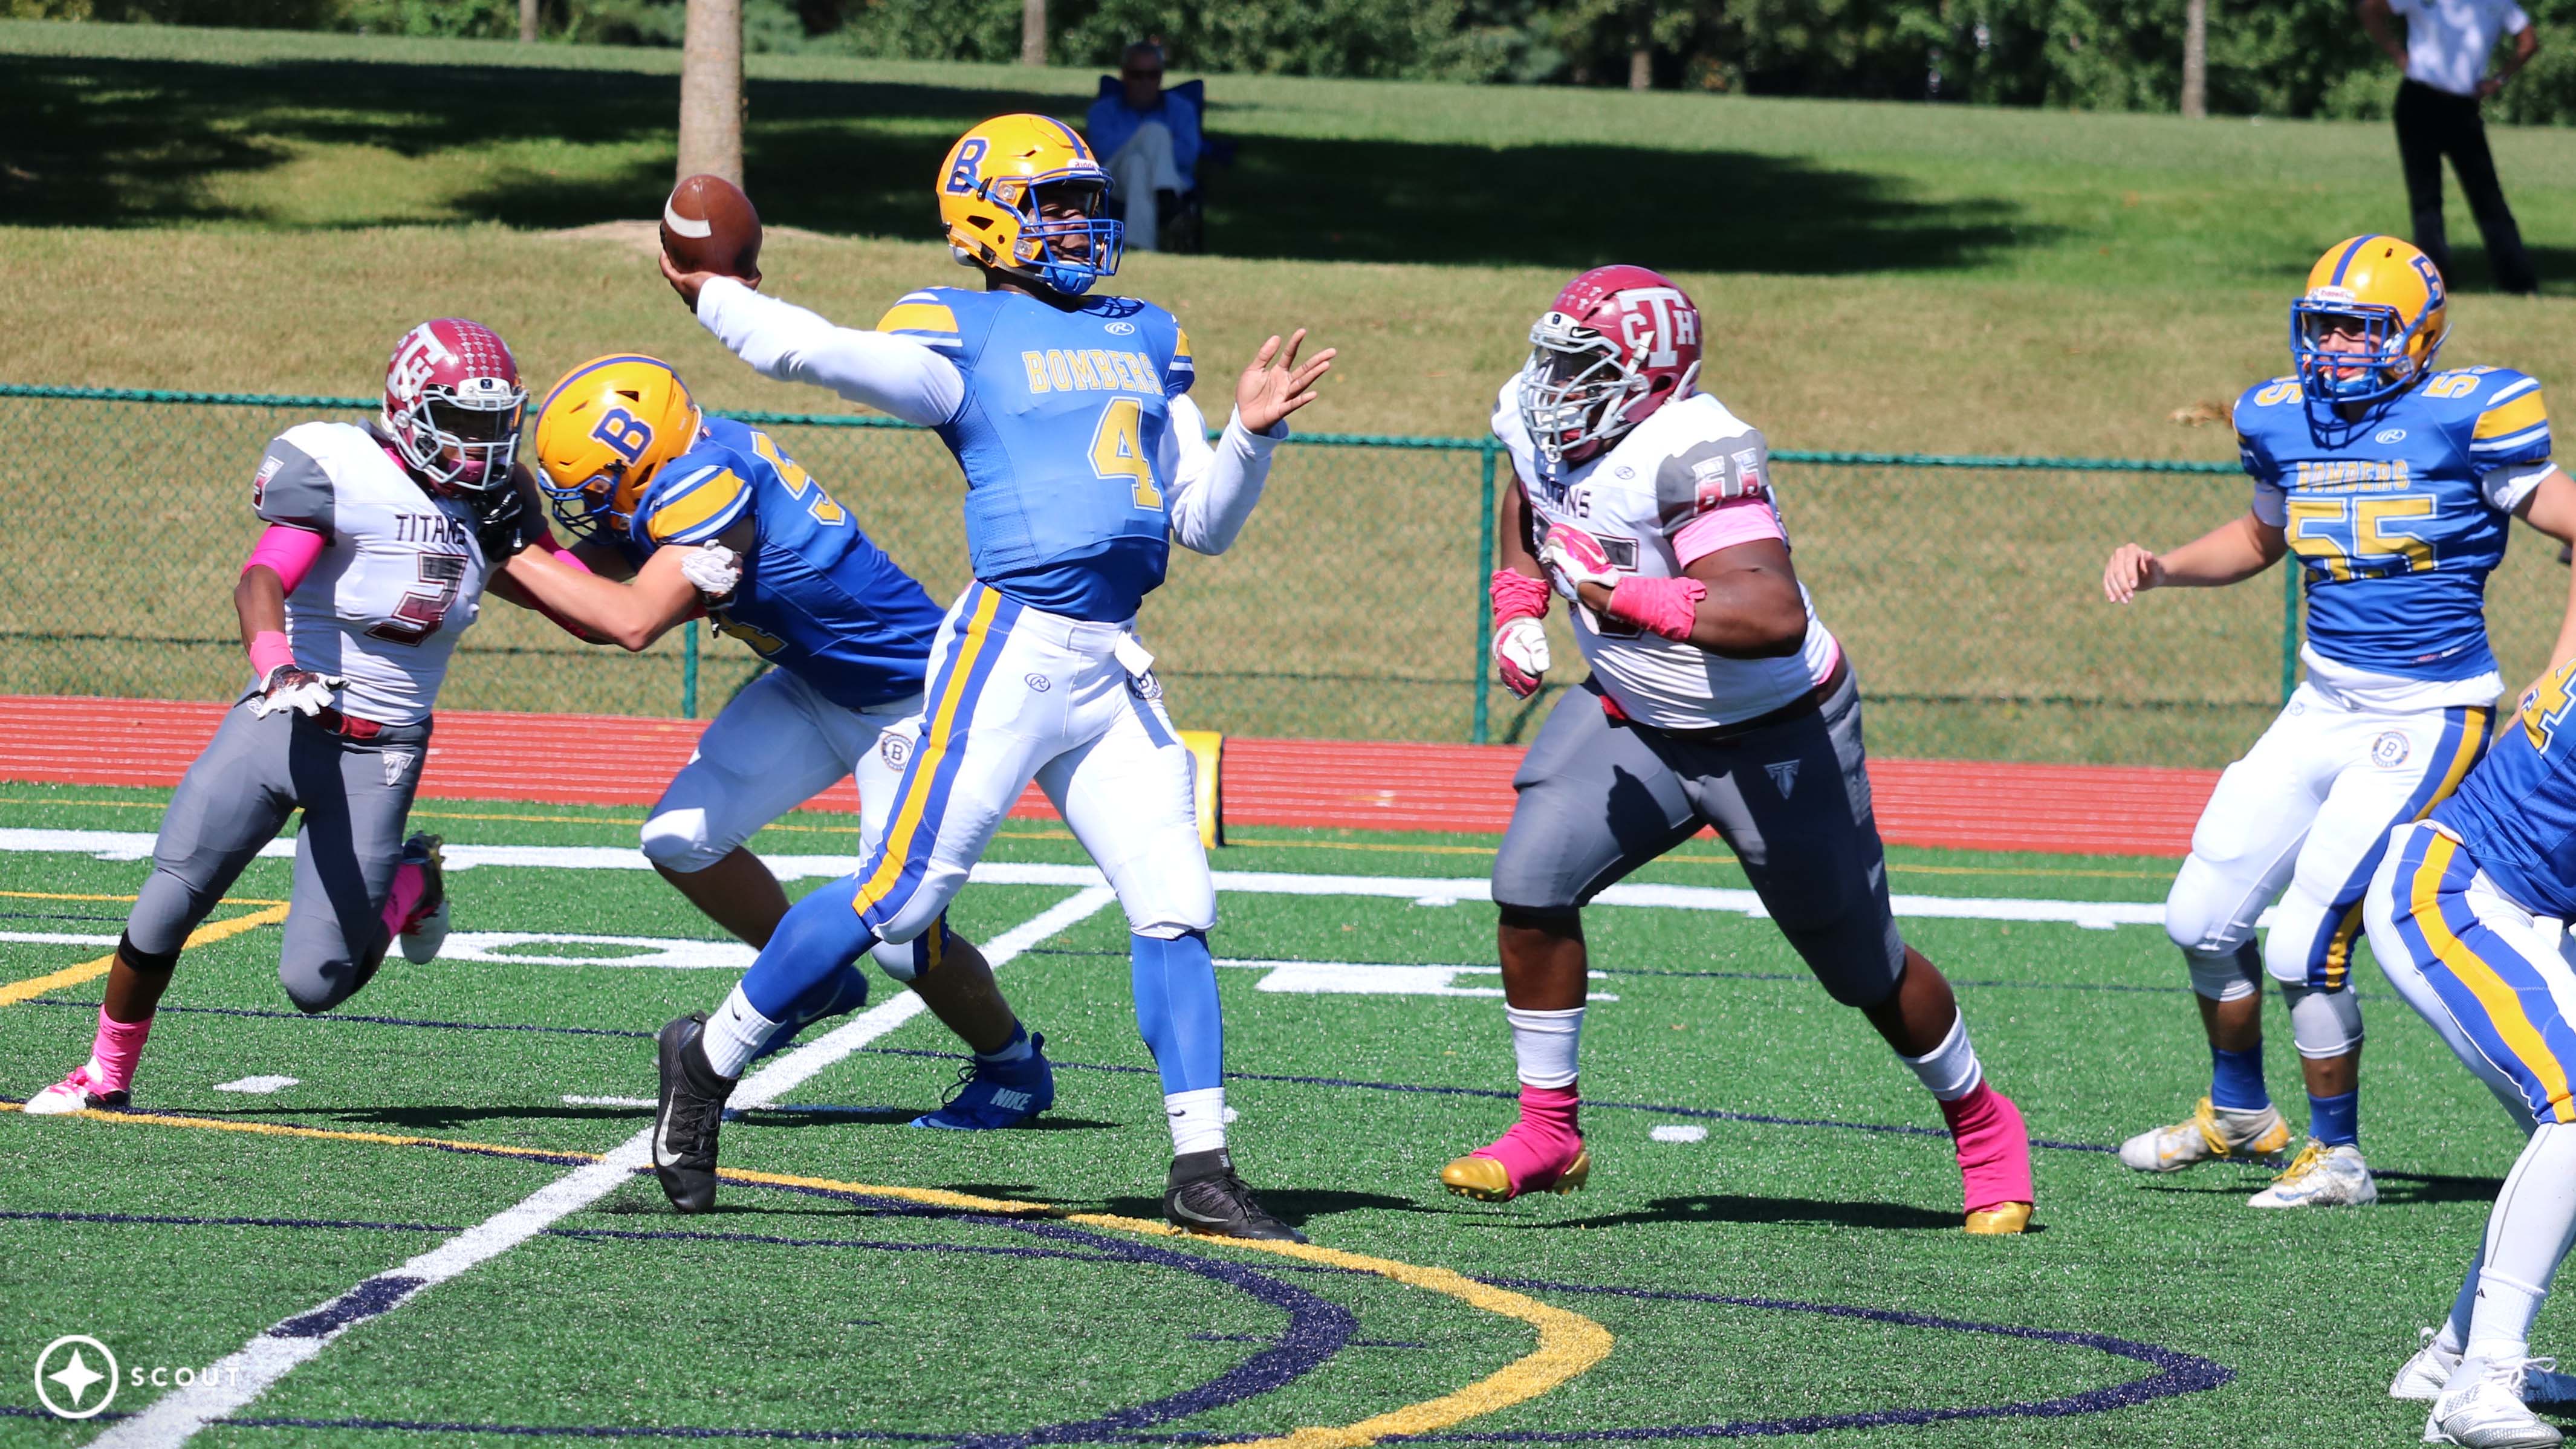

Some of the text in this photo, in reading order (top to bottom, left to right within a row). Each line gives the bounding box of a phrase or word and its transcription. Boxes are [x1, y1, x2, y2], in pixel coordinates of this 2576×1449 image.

[945, 136, 990, 198] B
[1022, 349, 1166, 397] BOMBERS
[588, 405, 655, 468] B
[1088, 396, 1164, 513] 4
[2296, 459, 2410, 493] BOMBERS
[395, 513, 466, 545] TITANS
[2284, 493, 2441, 582] 55
[891, 744, 903, 760] B
[990, 1088, 1032, 1112] NIKE
